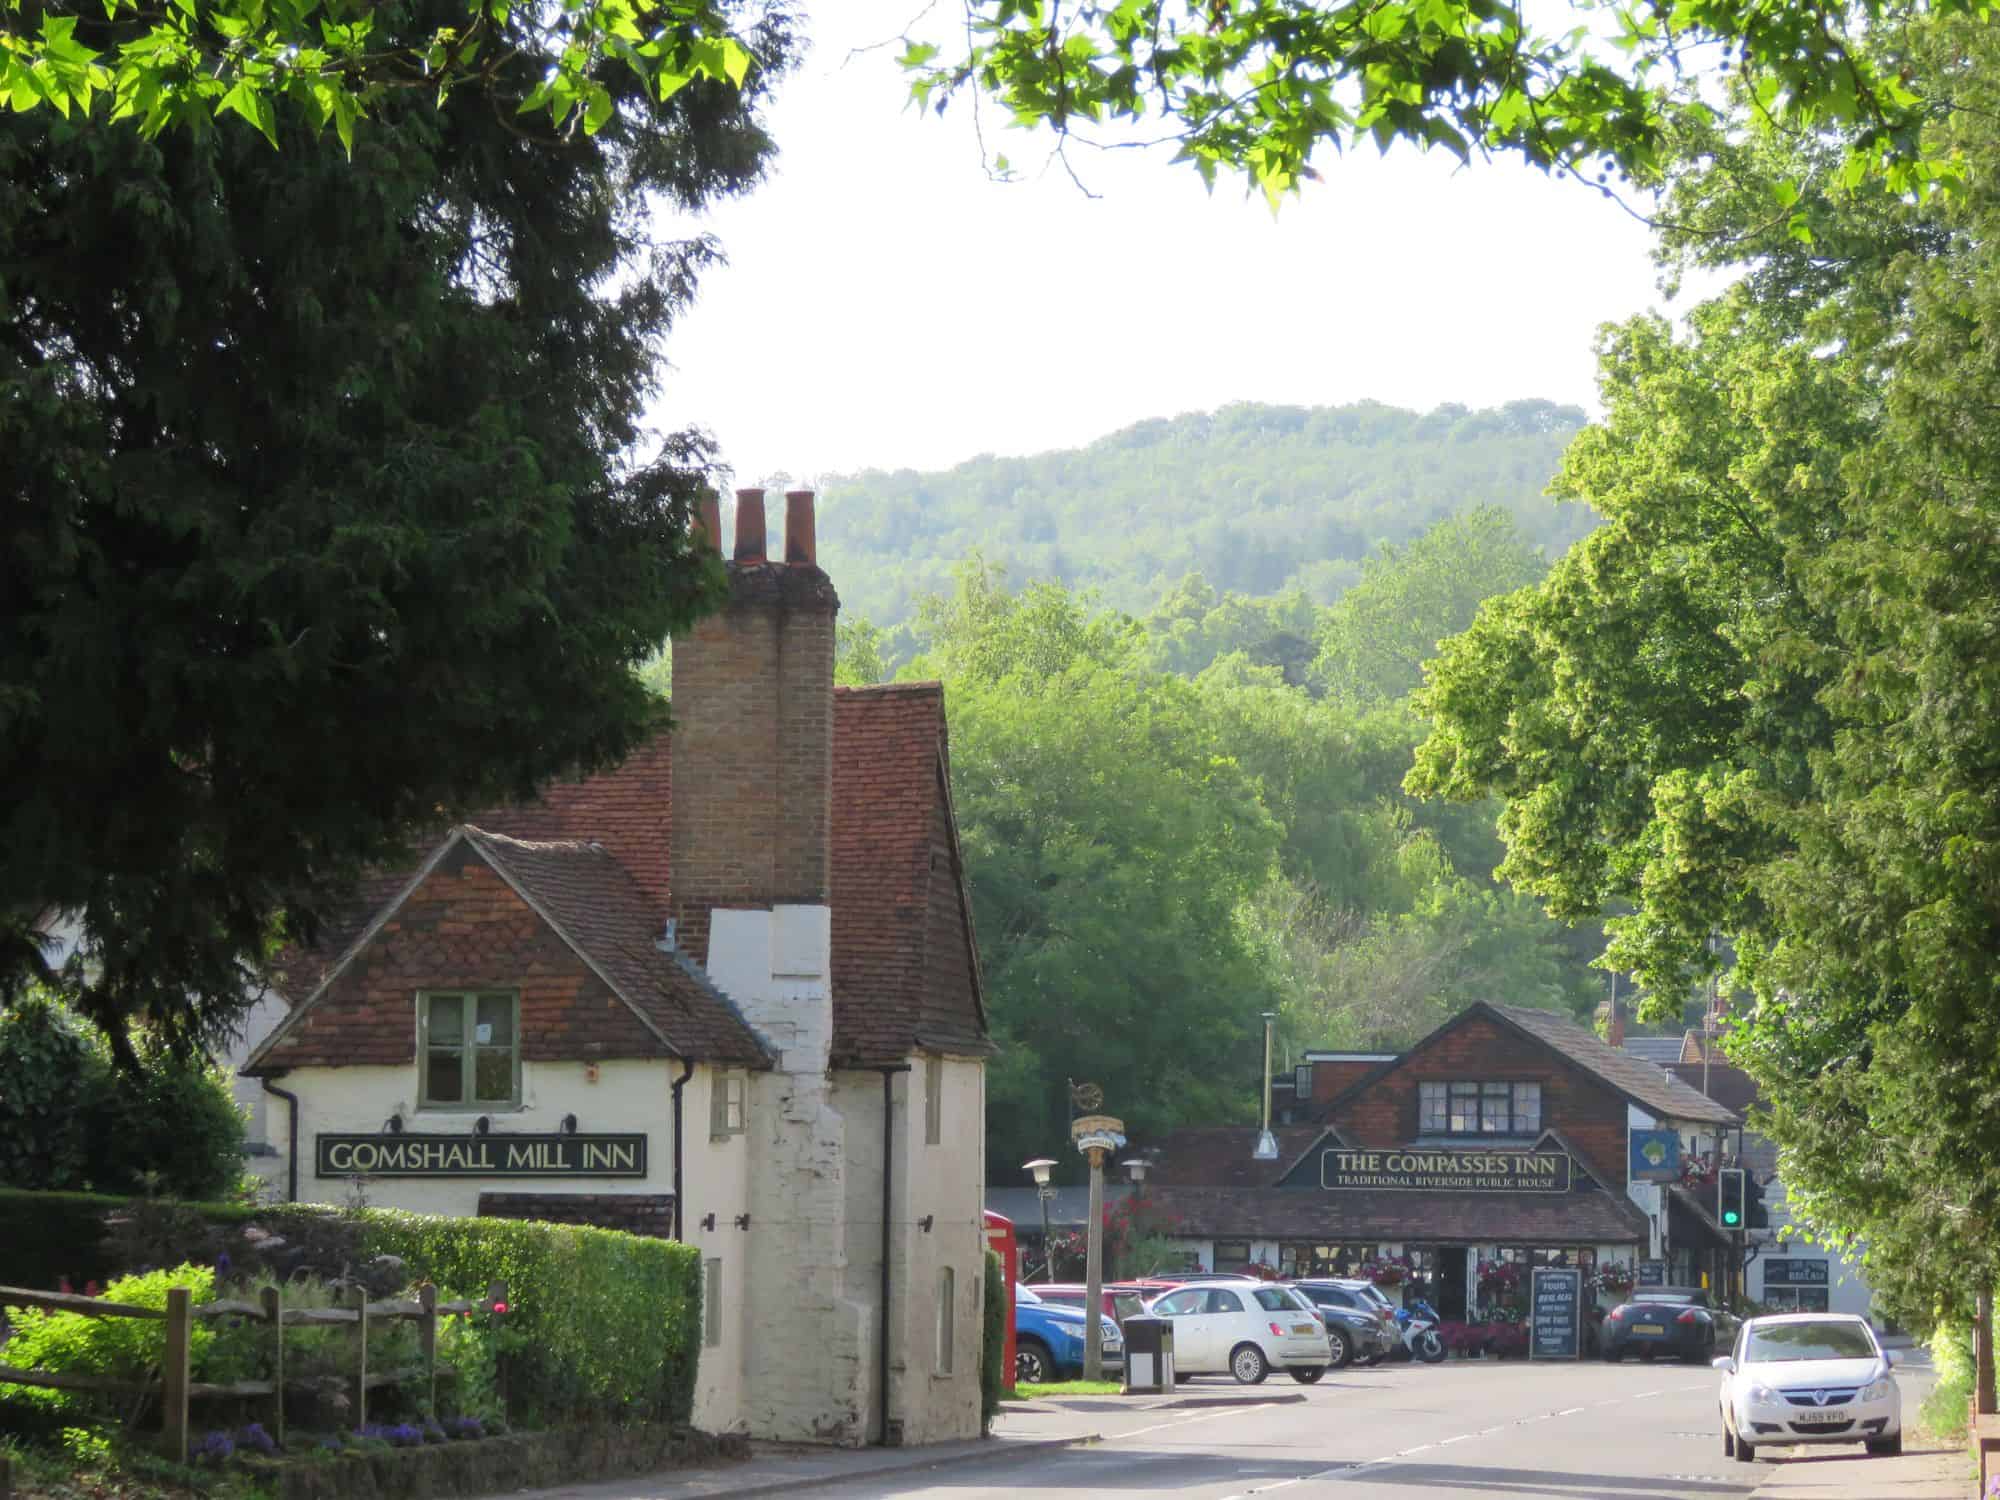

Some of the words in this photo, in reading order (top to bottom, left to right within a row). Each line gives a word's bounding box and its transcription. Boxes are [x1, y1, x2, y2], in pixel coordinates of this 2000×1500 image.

[329, 1143, 495, 1170] GOMSHALL
[507, 1143, 571, 1169] MILL
[582, 1143, 635, 1169] INN
[1336, 1153, 1380, 1172] THE
[1386, 1154, 1509, 1174] COMPASSES
[1515, 1156, 1556, 1174] INN
[1338, 1175, 1413, 1185] TRADITIONAL
[1415, 1176, 1473, 1187] RIVERSIDE
[1476, 1177, 1515, 1187] PUBLIC
[1518, 1178, 1553, 1187] HOUSE
